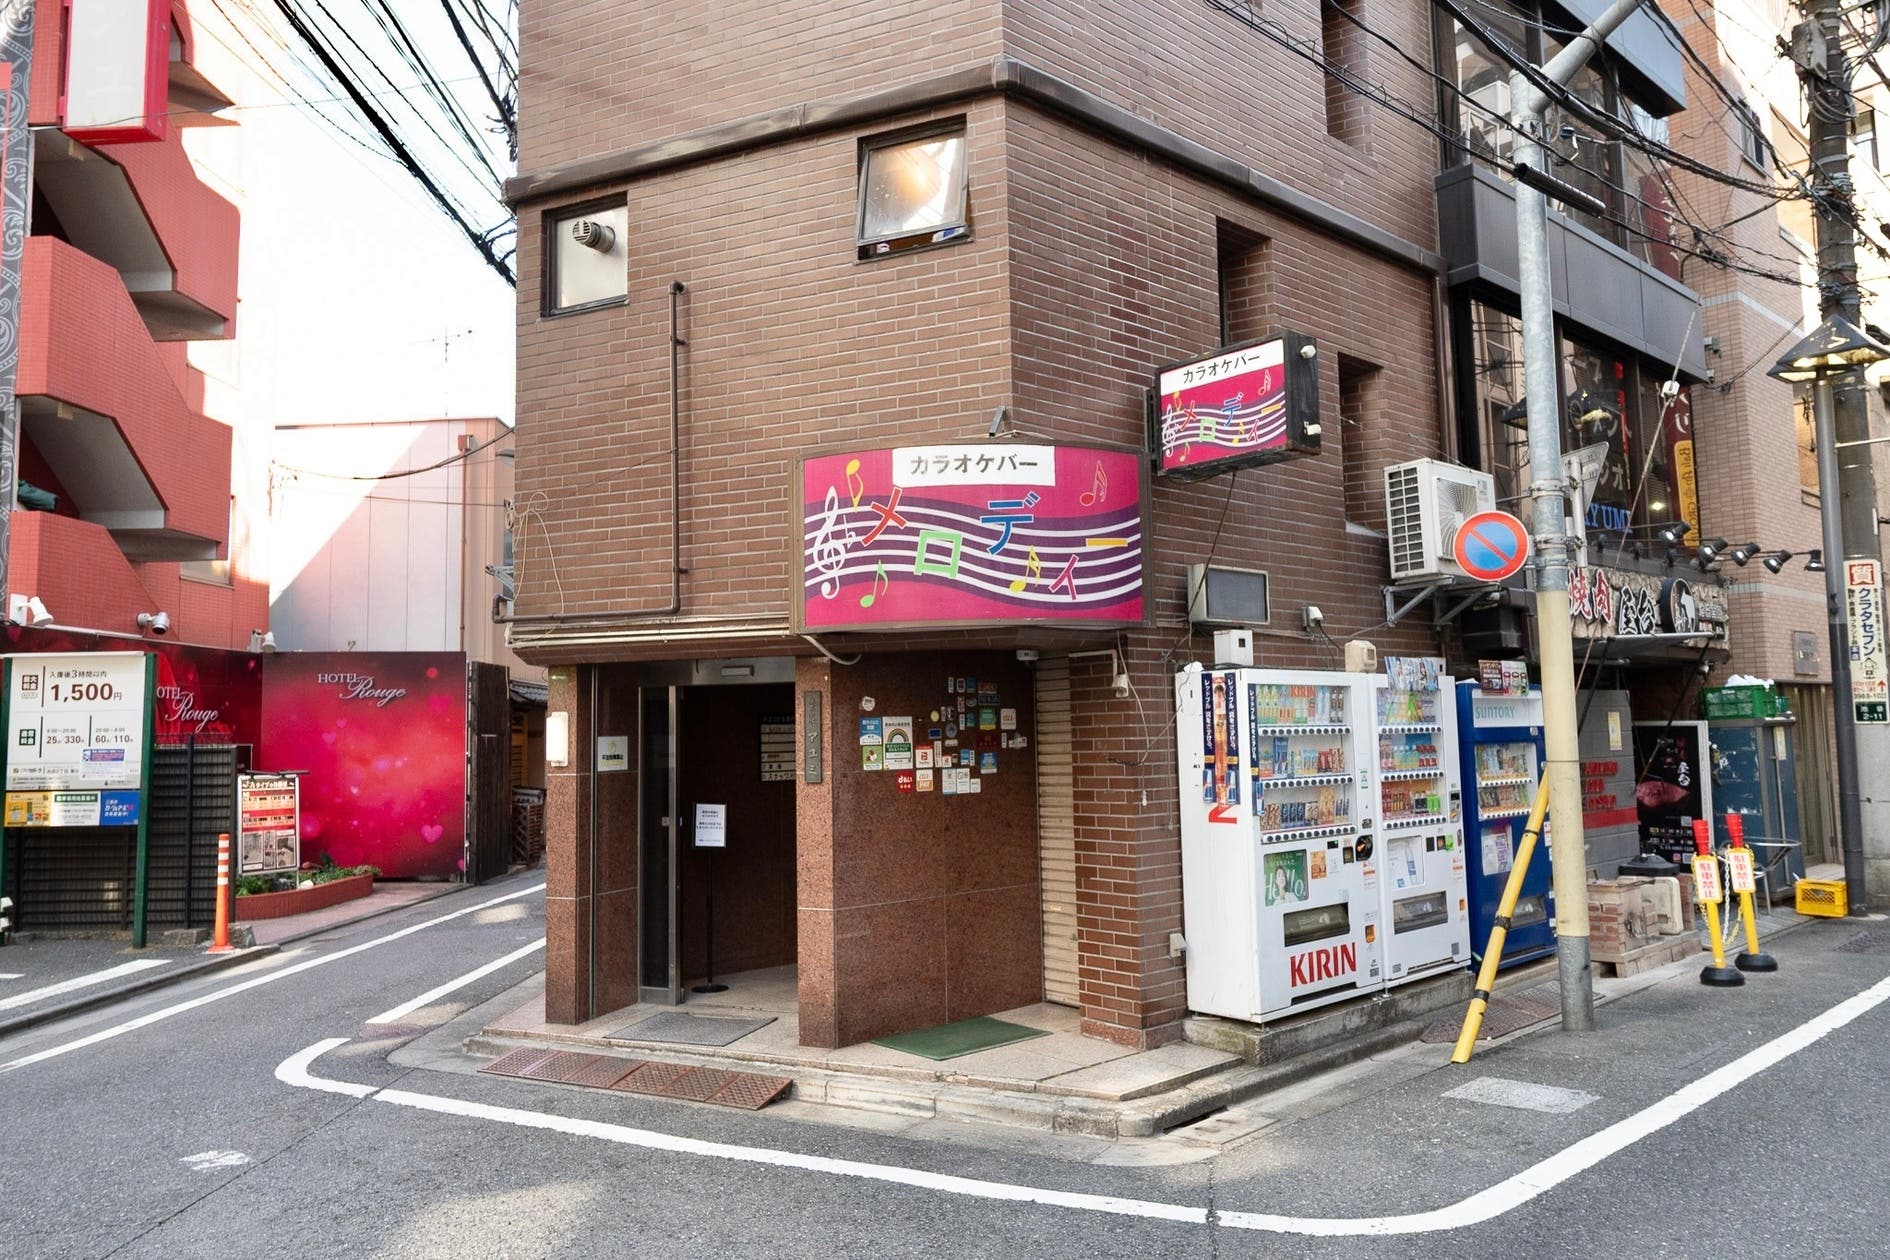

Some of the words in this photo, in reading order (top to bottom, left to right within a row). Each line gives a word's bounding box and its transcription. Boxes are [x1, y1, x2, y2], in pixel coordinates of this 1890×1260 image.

[1183, 354, 1260, 384] カラオケバー
[1180, 392, 1282, 442] メロディー
[911, 454, 1038, 475] カラオケバー
[861, 487, 1128, 600] メロディー
[51, 683, 122, 702] 1,500円
[156, 686, 182, 700] OTEL
[318, 673, 360, 684] HOTEL
[339, 676, 406, 707] Rouge
[165, 691, 219, 734] Rouge
[1475, 705, 1515, 719] SUNTORY
[1290, 942, 1357, 987] KIRIN
